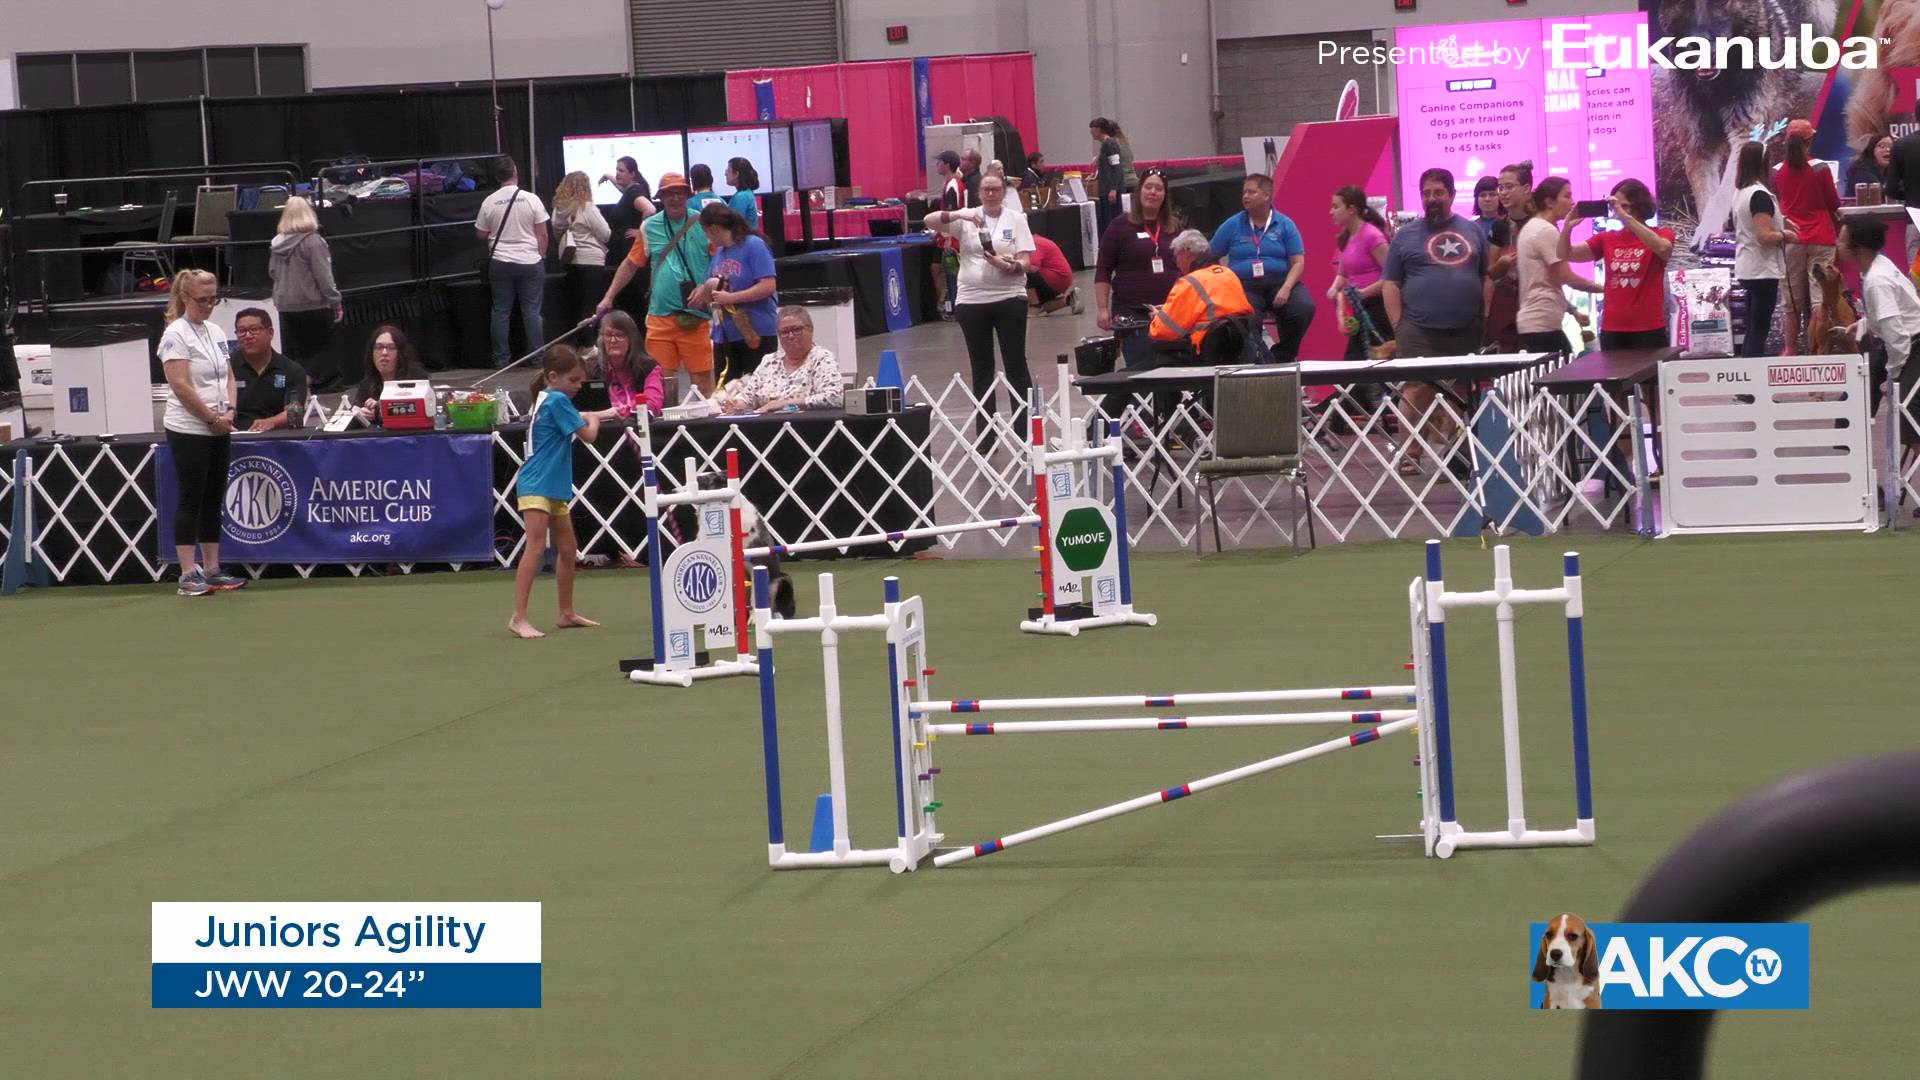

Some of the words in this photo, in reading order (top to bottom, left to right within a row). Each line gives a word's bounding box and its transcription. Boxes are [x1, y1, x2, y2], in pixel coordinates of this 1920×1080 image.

[1613, 87, 1631, 95] can
[1420, 103, 1456, 113] Canine
[1459, 99, 1525, 112] Companions
[1616, 98, 1635, 107] and
[1430, 118, 1456, 128] dogs
[1458, 117, 1475, 125] are
[1478, 113, 1516, 123] trained
[1612, 112, 1622, 120] in
[1437, 132, 1448, 140] to
[1451, 129, 1494, 140] perform
[1496, 128, 1510, 137] up
[1593, 126, 1617, 135] dogs
[1444, 145, 1455, 153] to
[1458, 143, 1472, 152] 45
[1475, 142, 1502, 151] tasks
[1716, 372, 1751, 383] PULL
[1769, 366, 1845, 383] MADAGILITY.COM
[248, 460, 283, 482] KENNEL
[280, 480, 293, 507] CLUB
[308, 476, 432, 501] AMERICAN
[229, 474, 281, 528] AKC
[307, 503, 380, 523] KENNEL
[384, 502, 432, 523] CLUB
[226, 523, 263, 540] FOUNDED
[350, 531, 391, 545] akc.org
[1061, 532, 1105, 547] YUMOVE
[684, 563, 716, 602] AKC
